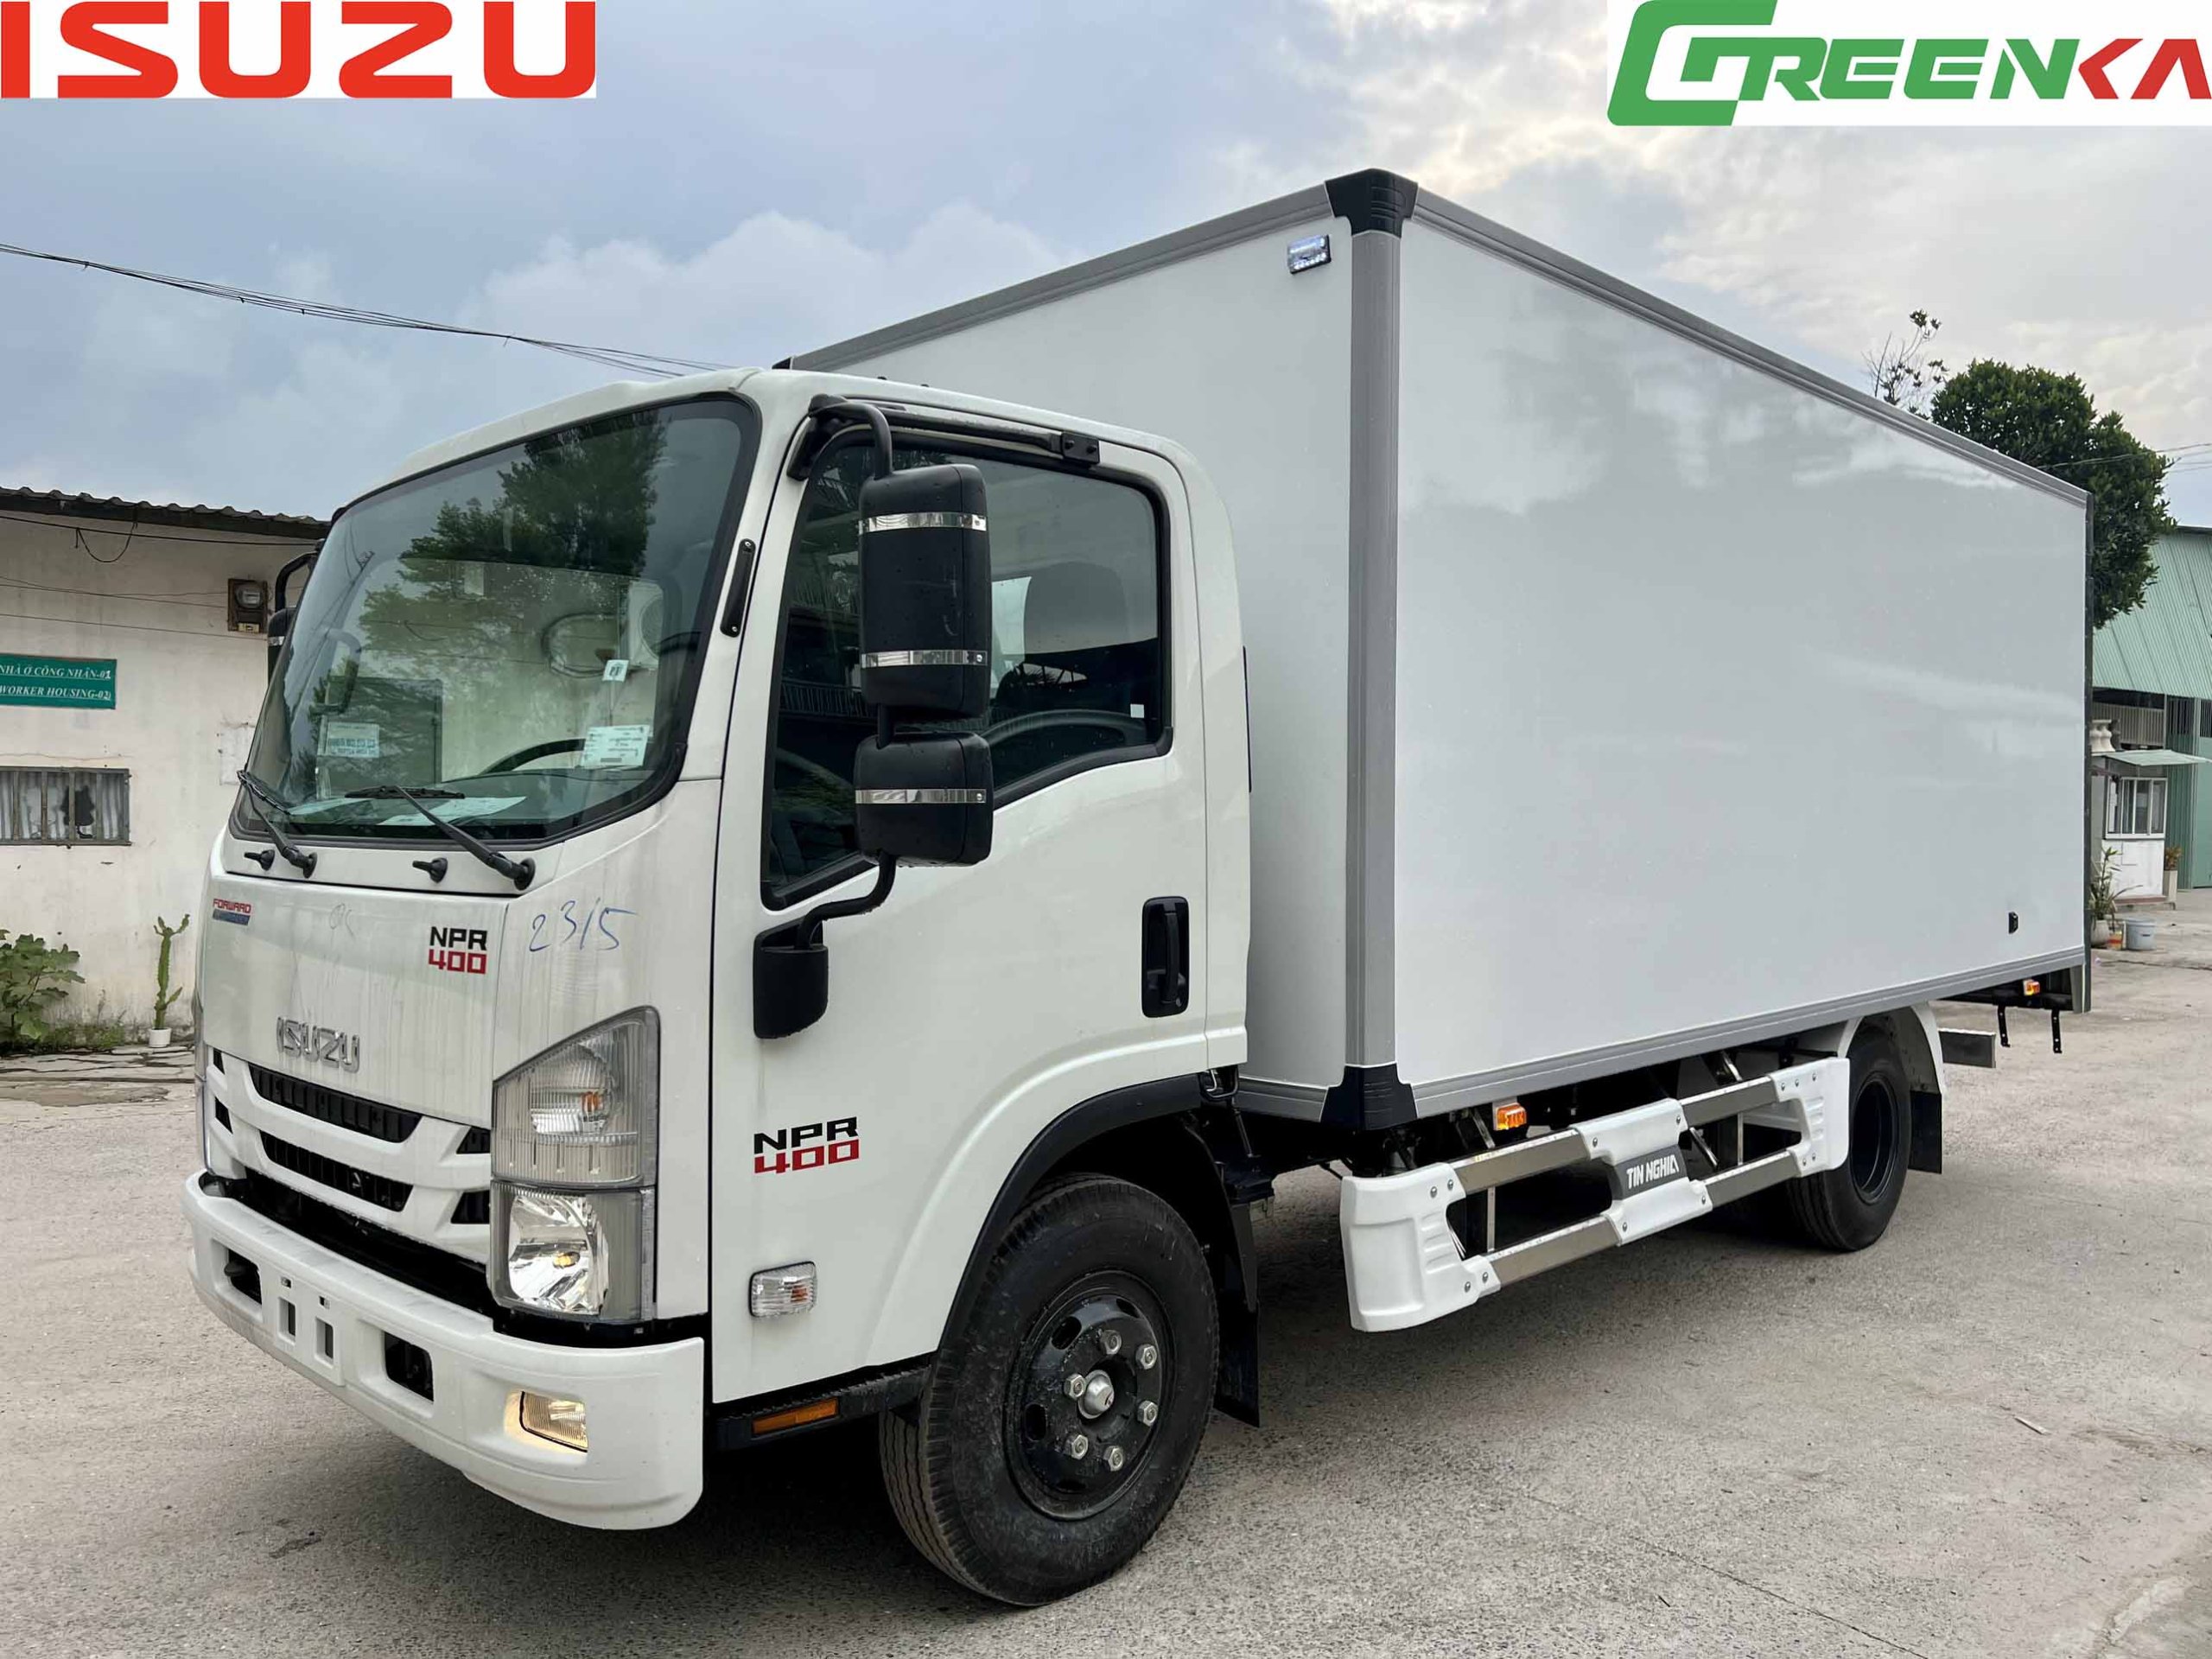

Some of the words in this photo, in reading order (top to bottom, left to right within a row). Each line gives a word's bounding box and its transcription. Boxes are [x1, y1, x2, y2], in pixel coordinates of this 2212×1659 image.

[213, 898, 251, 914] FORWARD
[429, 926, 488, 951] NPR
[429, 949, 486, 975] 400
[276, 1016, 360, 1073] ISUZU
[753, 1116, 859, 1154] NPR
[754, 1139, 860, 1174] 400
[1626, 1164, 1644, 1189] TIN
